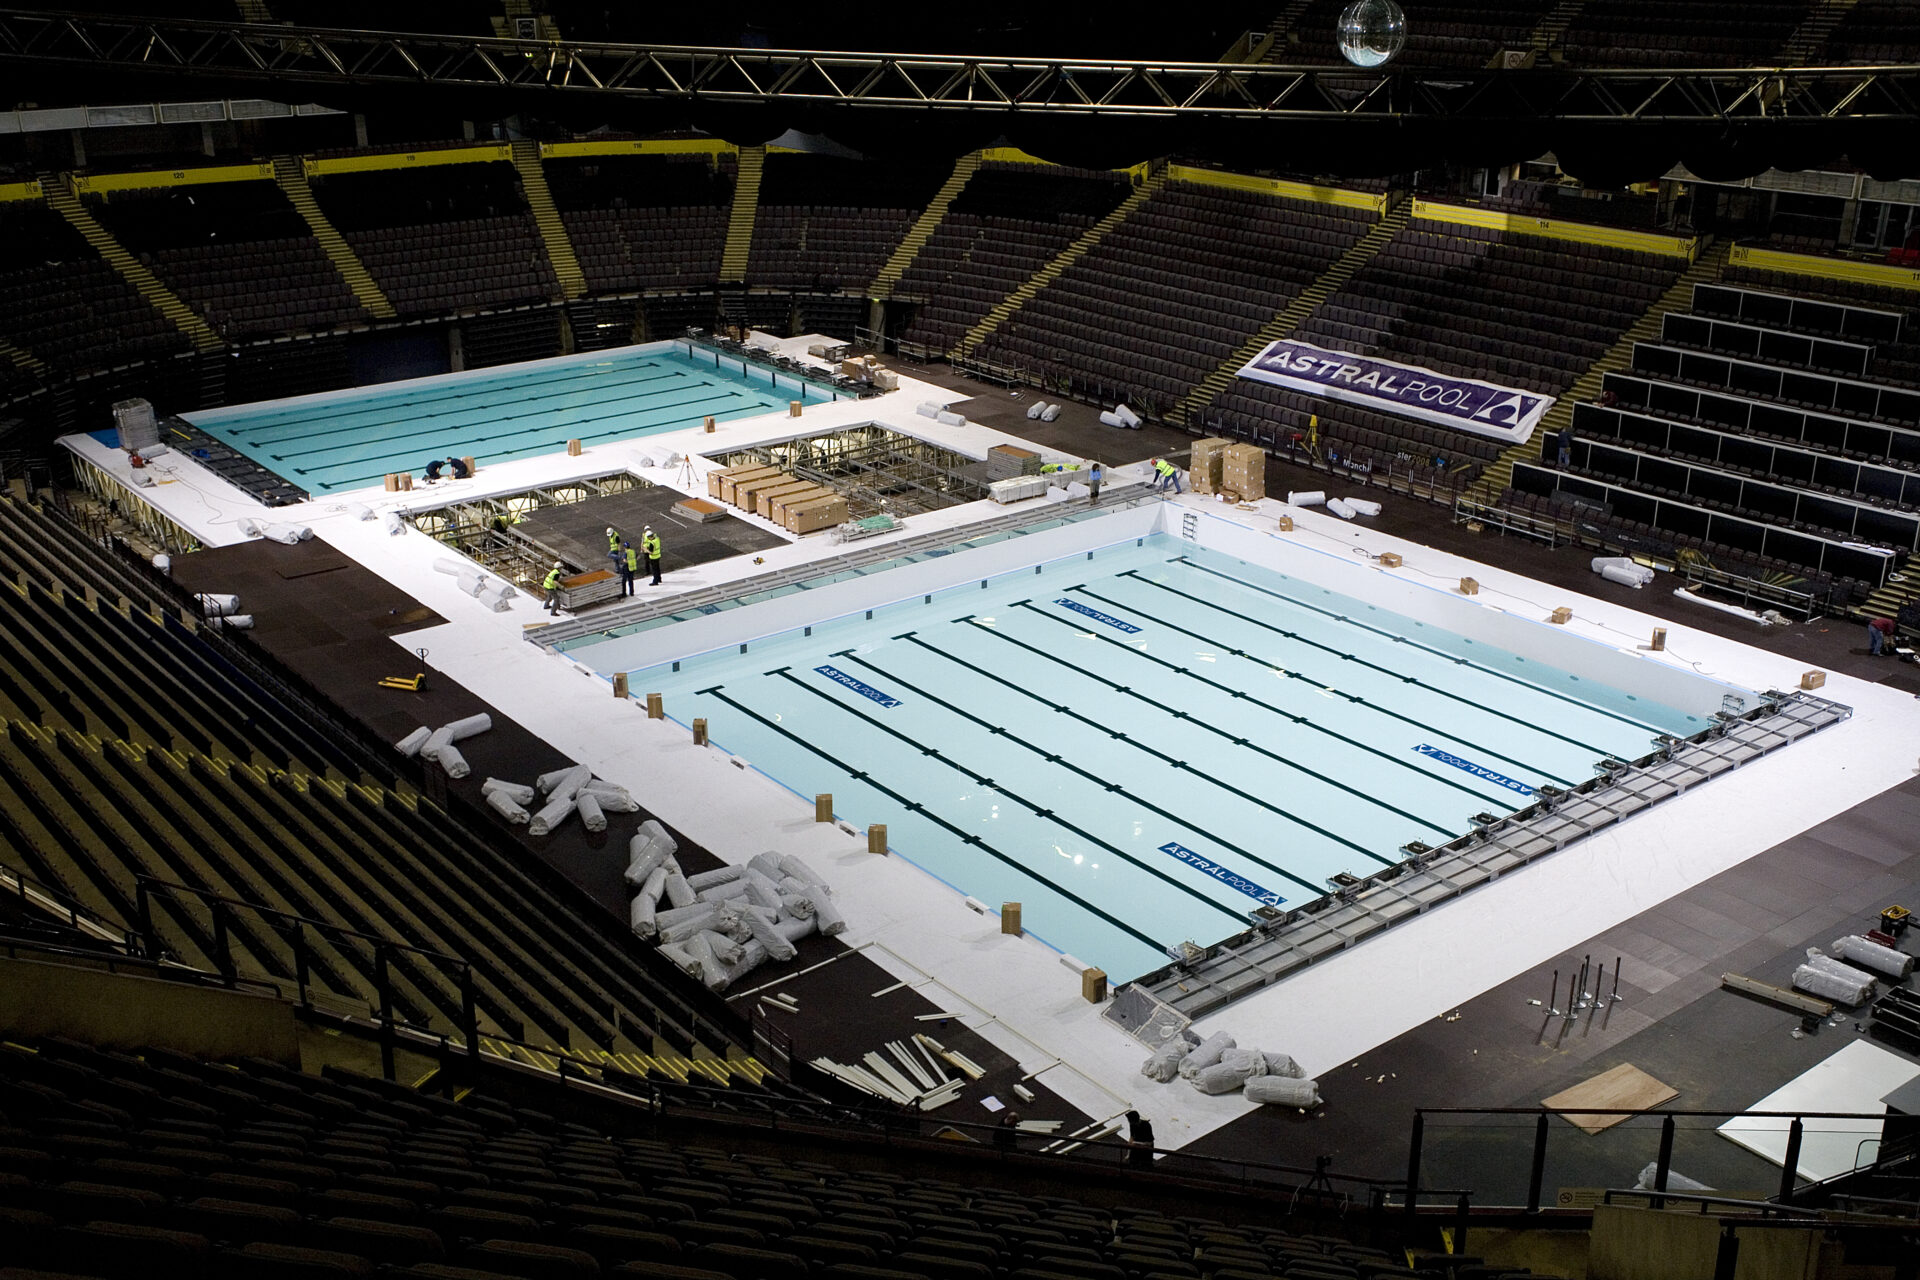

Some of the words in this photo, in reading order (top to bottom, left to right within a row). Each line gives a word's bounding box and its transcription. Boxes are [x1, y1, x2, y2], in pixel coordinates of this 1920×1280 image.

[1540, 221, 1549, 229] 114
[1264, 351, 1472, 411] ASTRALPOOL
[1071, 603, 1139, 632] ASTRALPOOL
[818, 667, 883, 701] ASTRALPOOL
[1437, 751, 1534, 793] ASTRALPOOL
[1164, 845, 1261, 896] ASTRALPOOL
